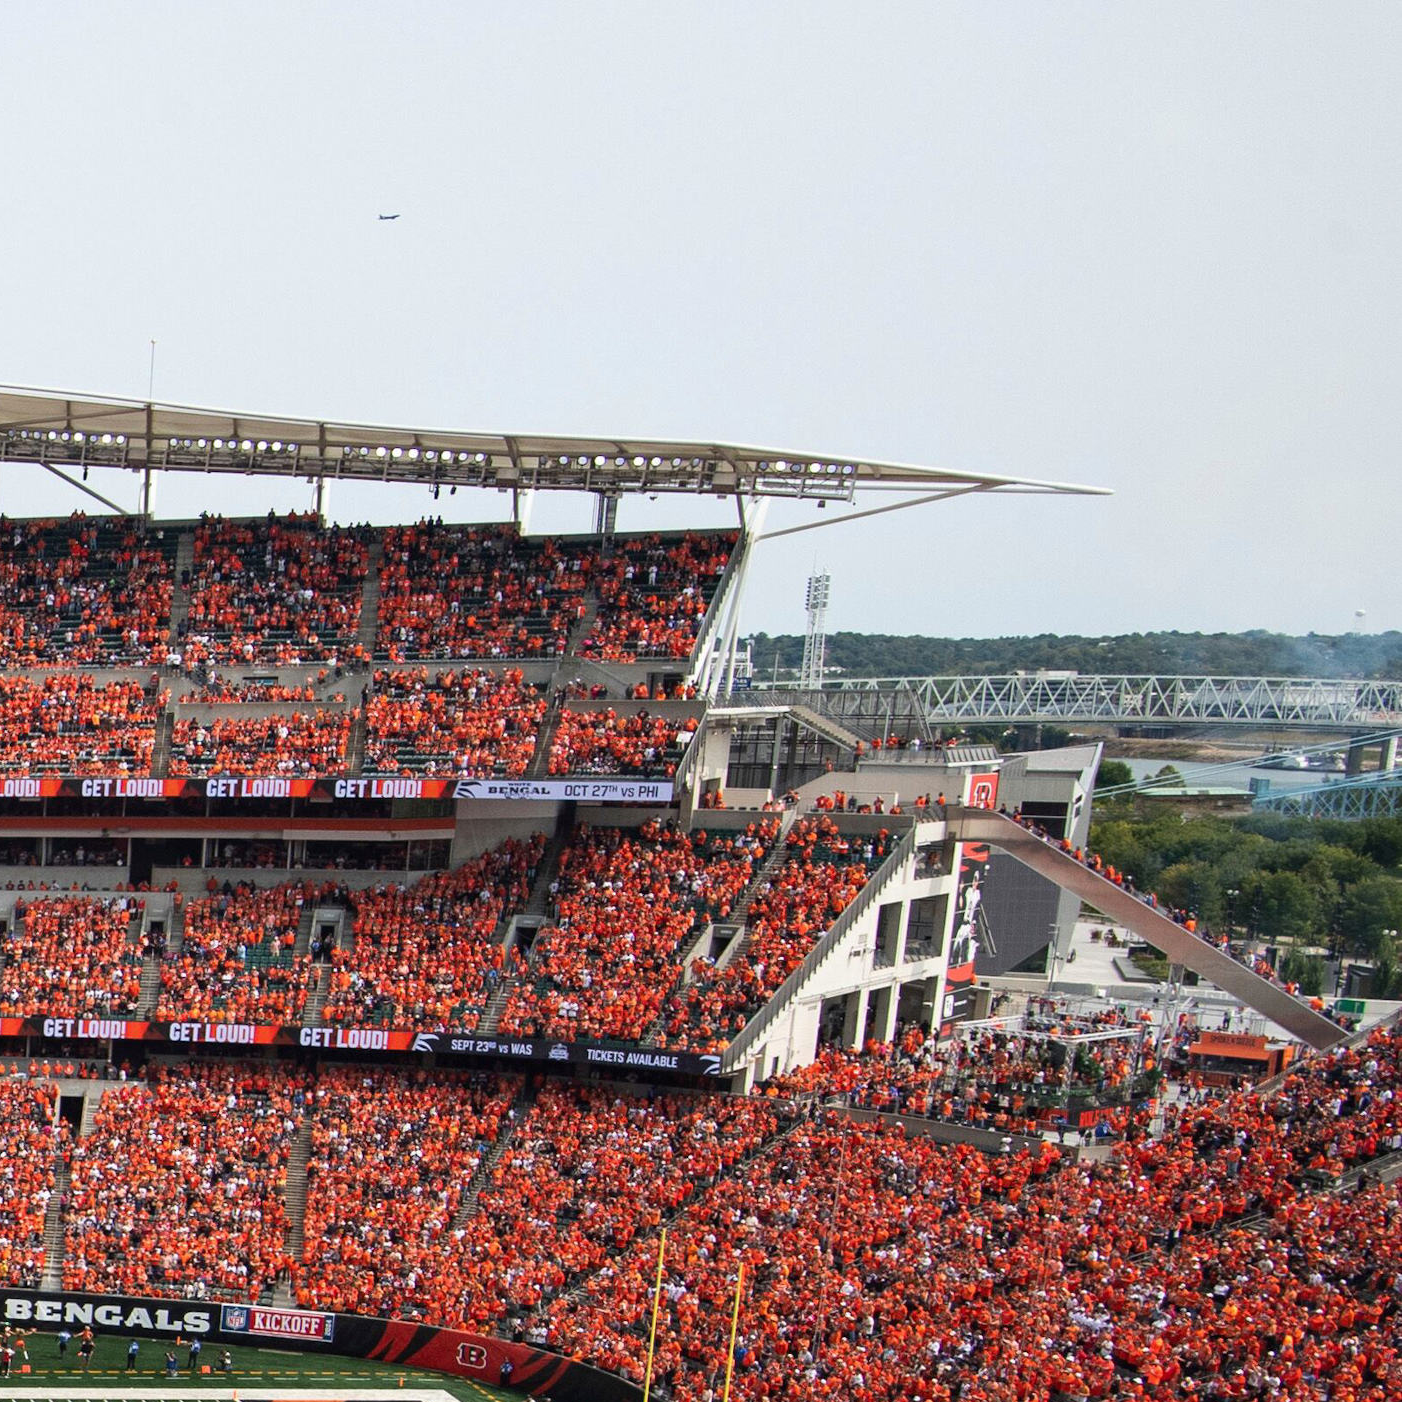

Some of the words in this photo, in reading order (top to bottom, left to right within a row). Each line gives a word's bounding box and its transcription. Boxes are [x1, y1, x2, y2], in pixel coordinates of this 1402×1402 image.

[82, 780, 111, 796] GET
[115, 778, 163, 796] LOUD!
[207, 780, 237, 796] GET
[241, 778, 290, 796] LOUD!
[335, 780, 366, 797] GET
[370, 779, 421, 797] LOUD!
[488, 786, 550, 796] BENGAL
[564, 784, 589, 797] OCT
[592, 784, 618, 798] 27TH
[638, 785, 659, 798] PHI
[44, 1019, 73, 1037] GET
[77, 1020, 125, 1038] LOUD!
[170, 1023, 200, 1041] GET
[204, 1025, 254, 1043] LOUD!
[300, 1028, 332, 1046] GET
[336, 1031, 388, 1049] LOUD!
[451, 1038, 475, 1051] SEPT
[511, 1043, 532, 1056] WAS
[587, 1048, 625, 1064] TICKETS
[626, 1052, 678, 1069] AVAILABLE
[4, 1298, 211, 1333] BENGALS
[253, 1311, 320, 1334] KICKOFF
